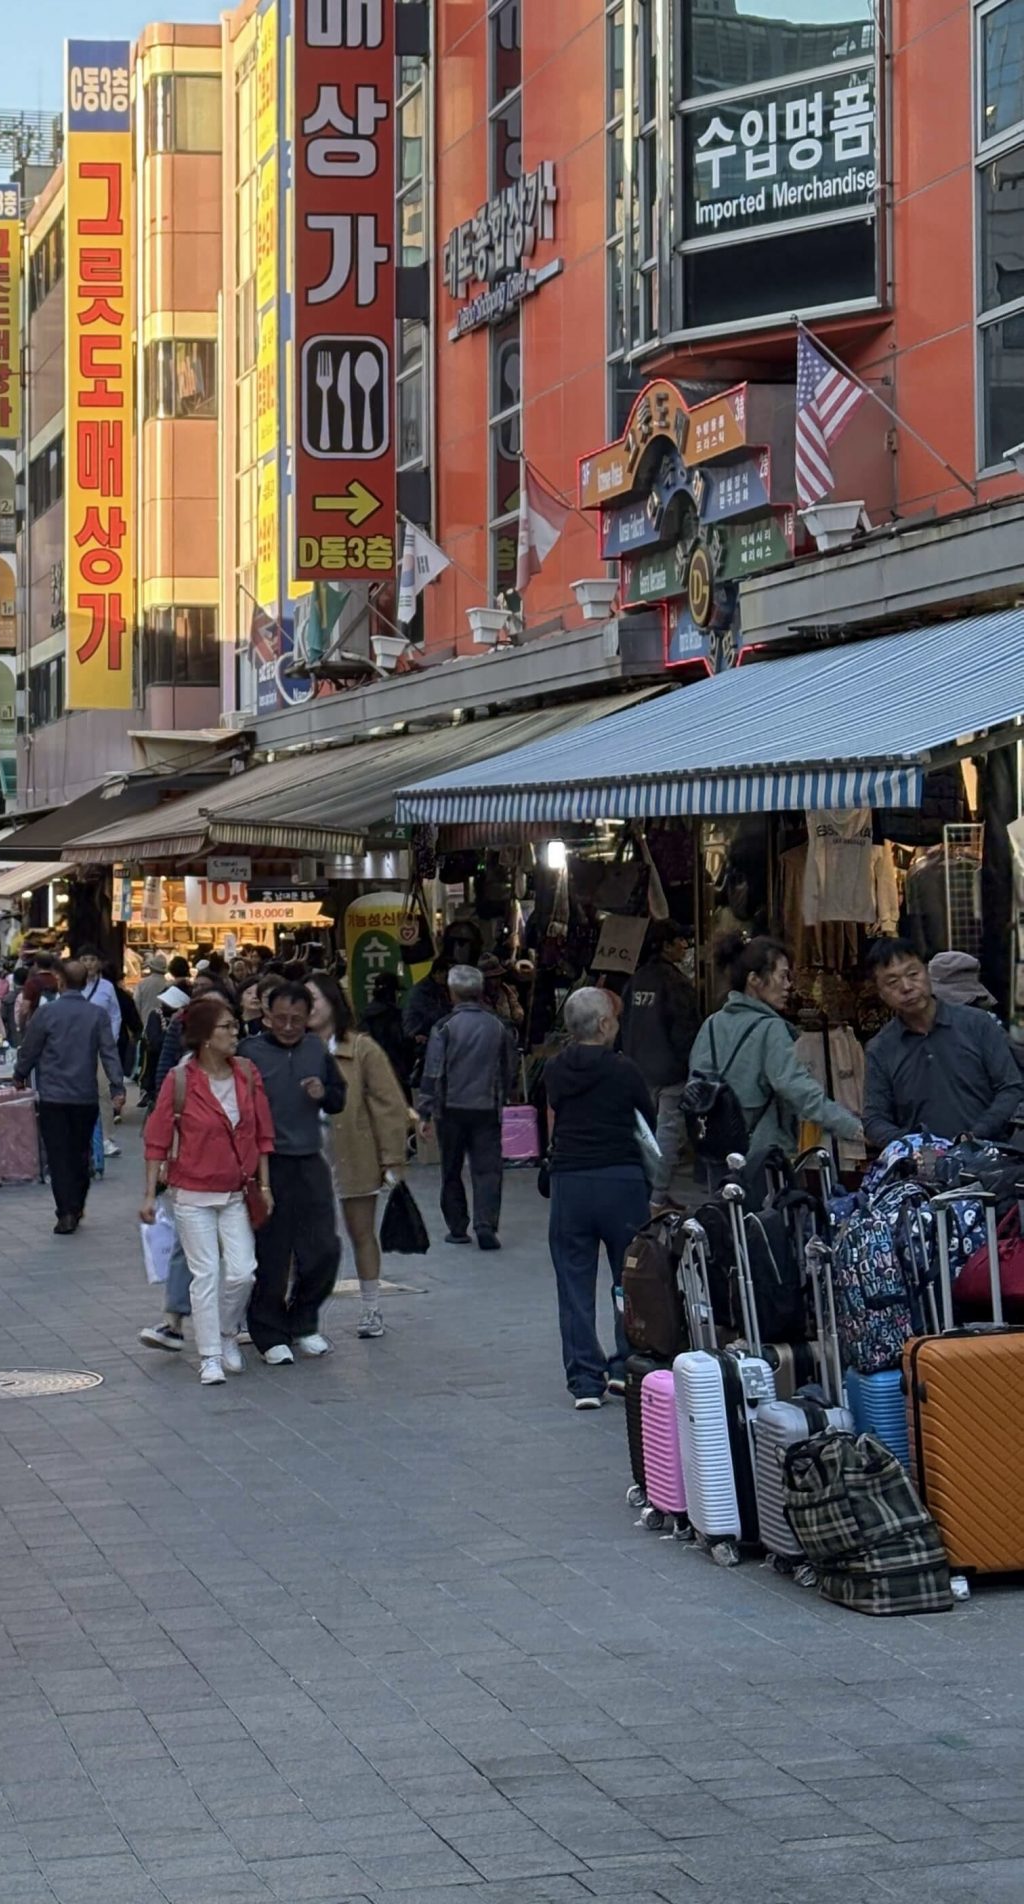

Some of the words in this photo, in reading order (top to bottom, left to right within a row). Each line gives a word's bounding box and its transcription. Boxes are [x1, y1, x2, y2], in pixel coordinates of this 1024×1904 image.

[70, 66, 128, 112] C동3층
[695, 84, 874, 189] 수입명품
[695, 186, 765, 228] Imported
[772, 167, 875, 208] Merchandise
[73, 161, 127, 671] 그릇도매상가
[298, 535, 393, 570] D동3층
[249, 907, 295, 919] 18,000원
